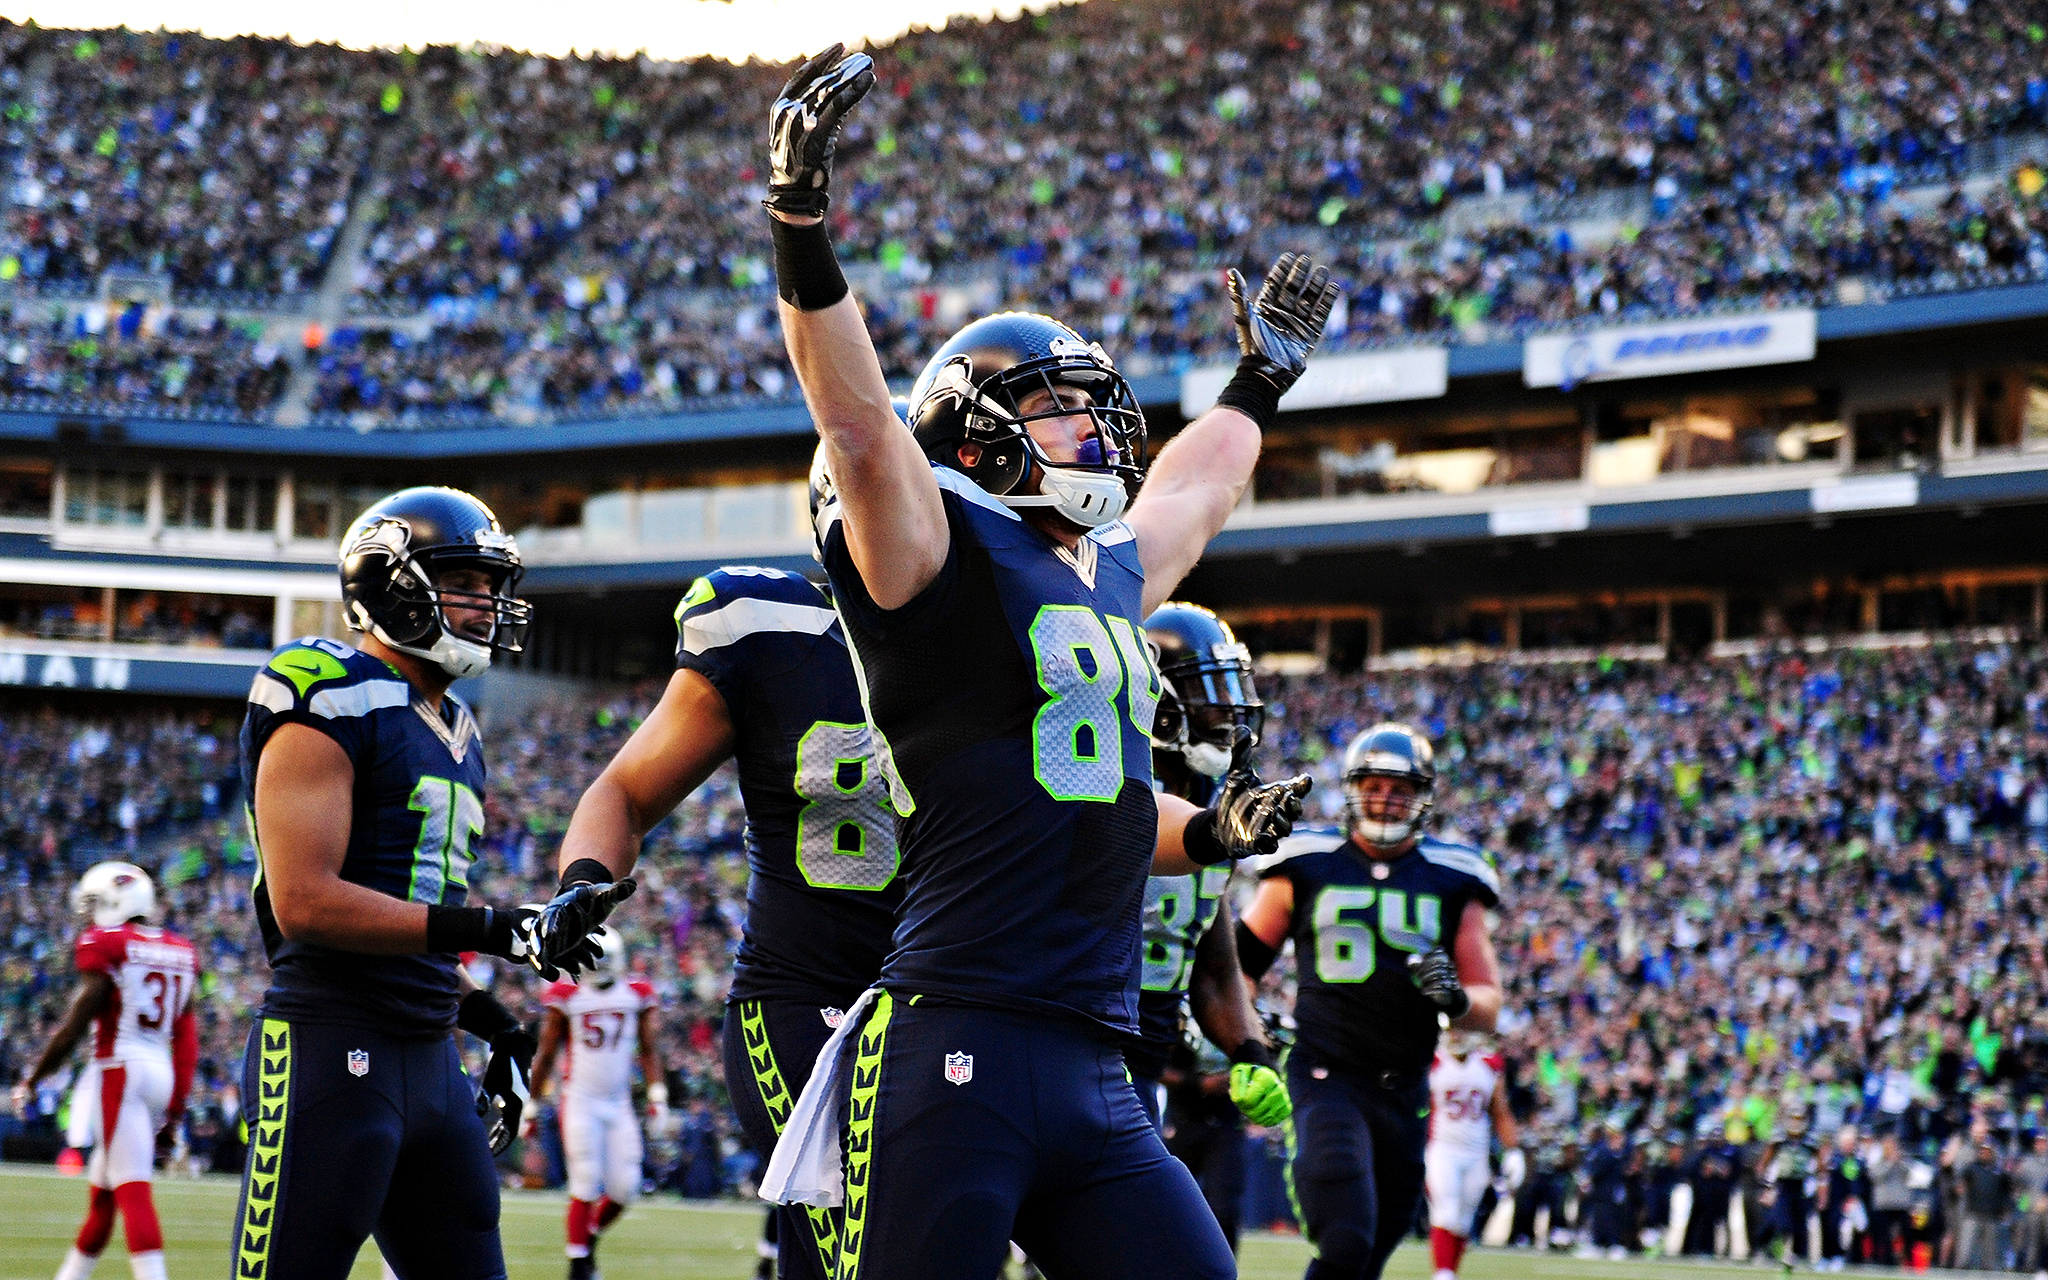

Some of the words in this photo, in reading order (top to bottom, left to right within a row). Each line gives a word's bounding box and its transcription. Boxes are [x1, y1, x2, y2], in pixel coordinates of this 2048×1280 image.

[1028, 604, 1163, 804] 84
[1312, 885, 1442, 984] 64
[137, 971, 182, 1029] 31
[582, 1011, 625, 1050] 57
[949, 1066, 969, 1079] NFL
